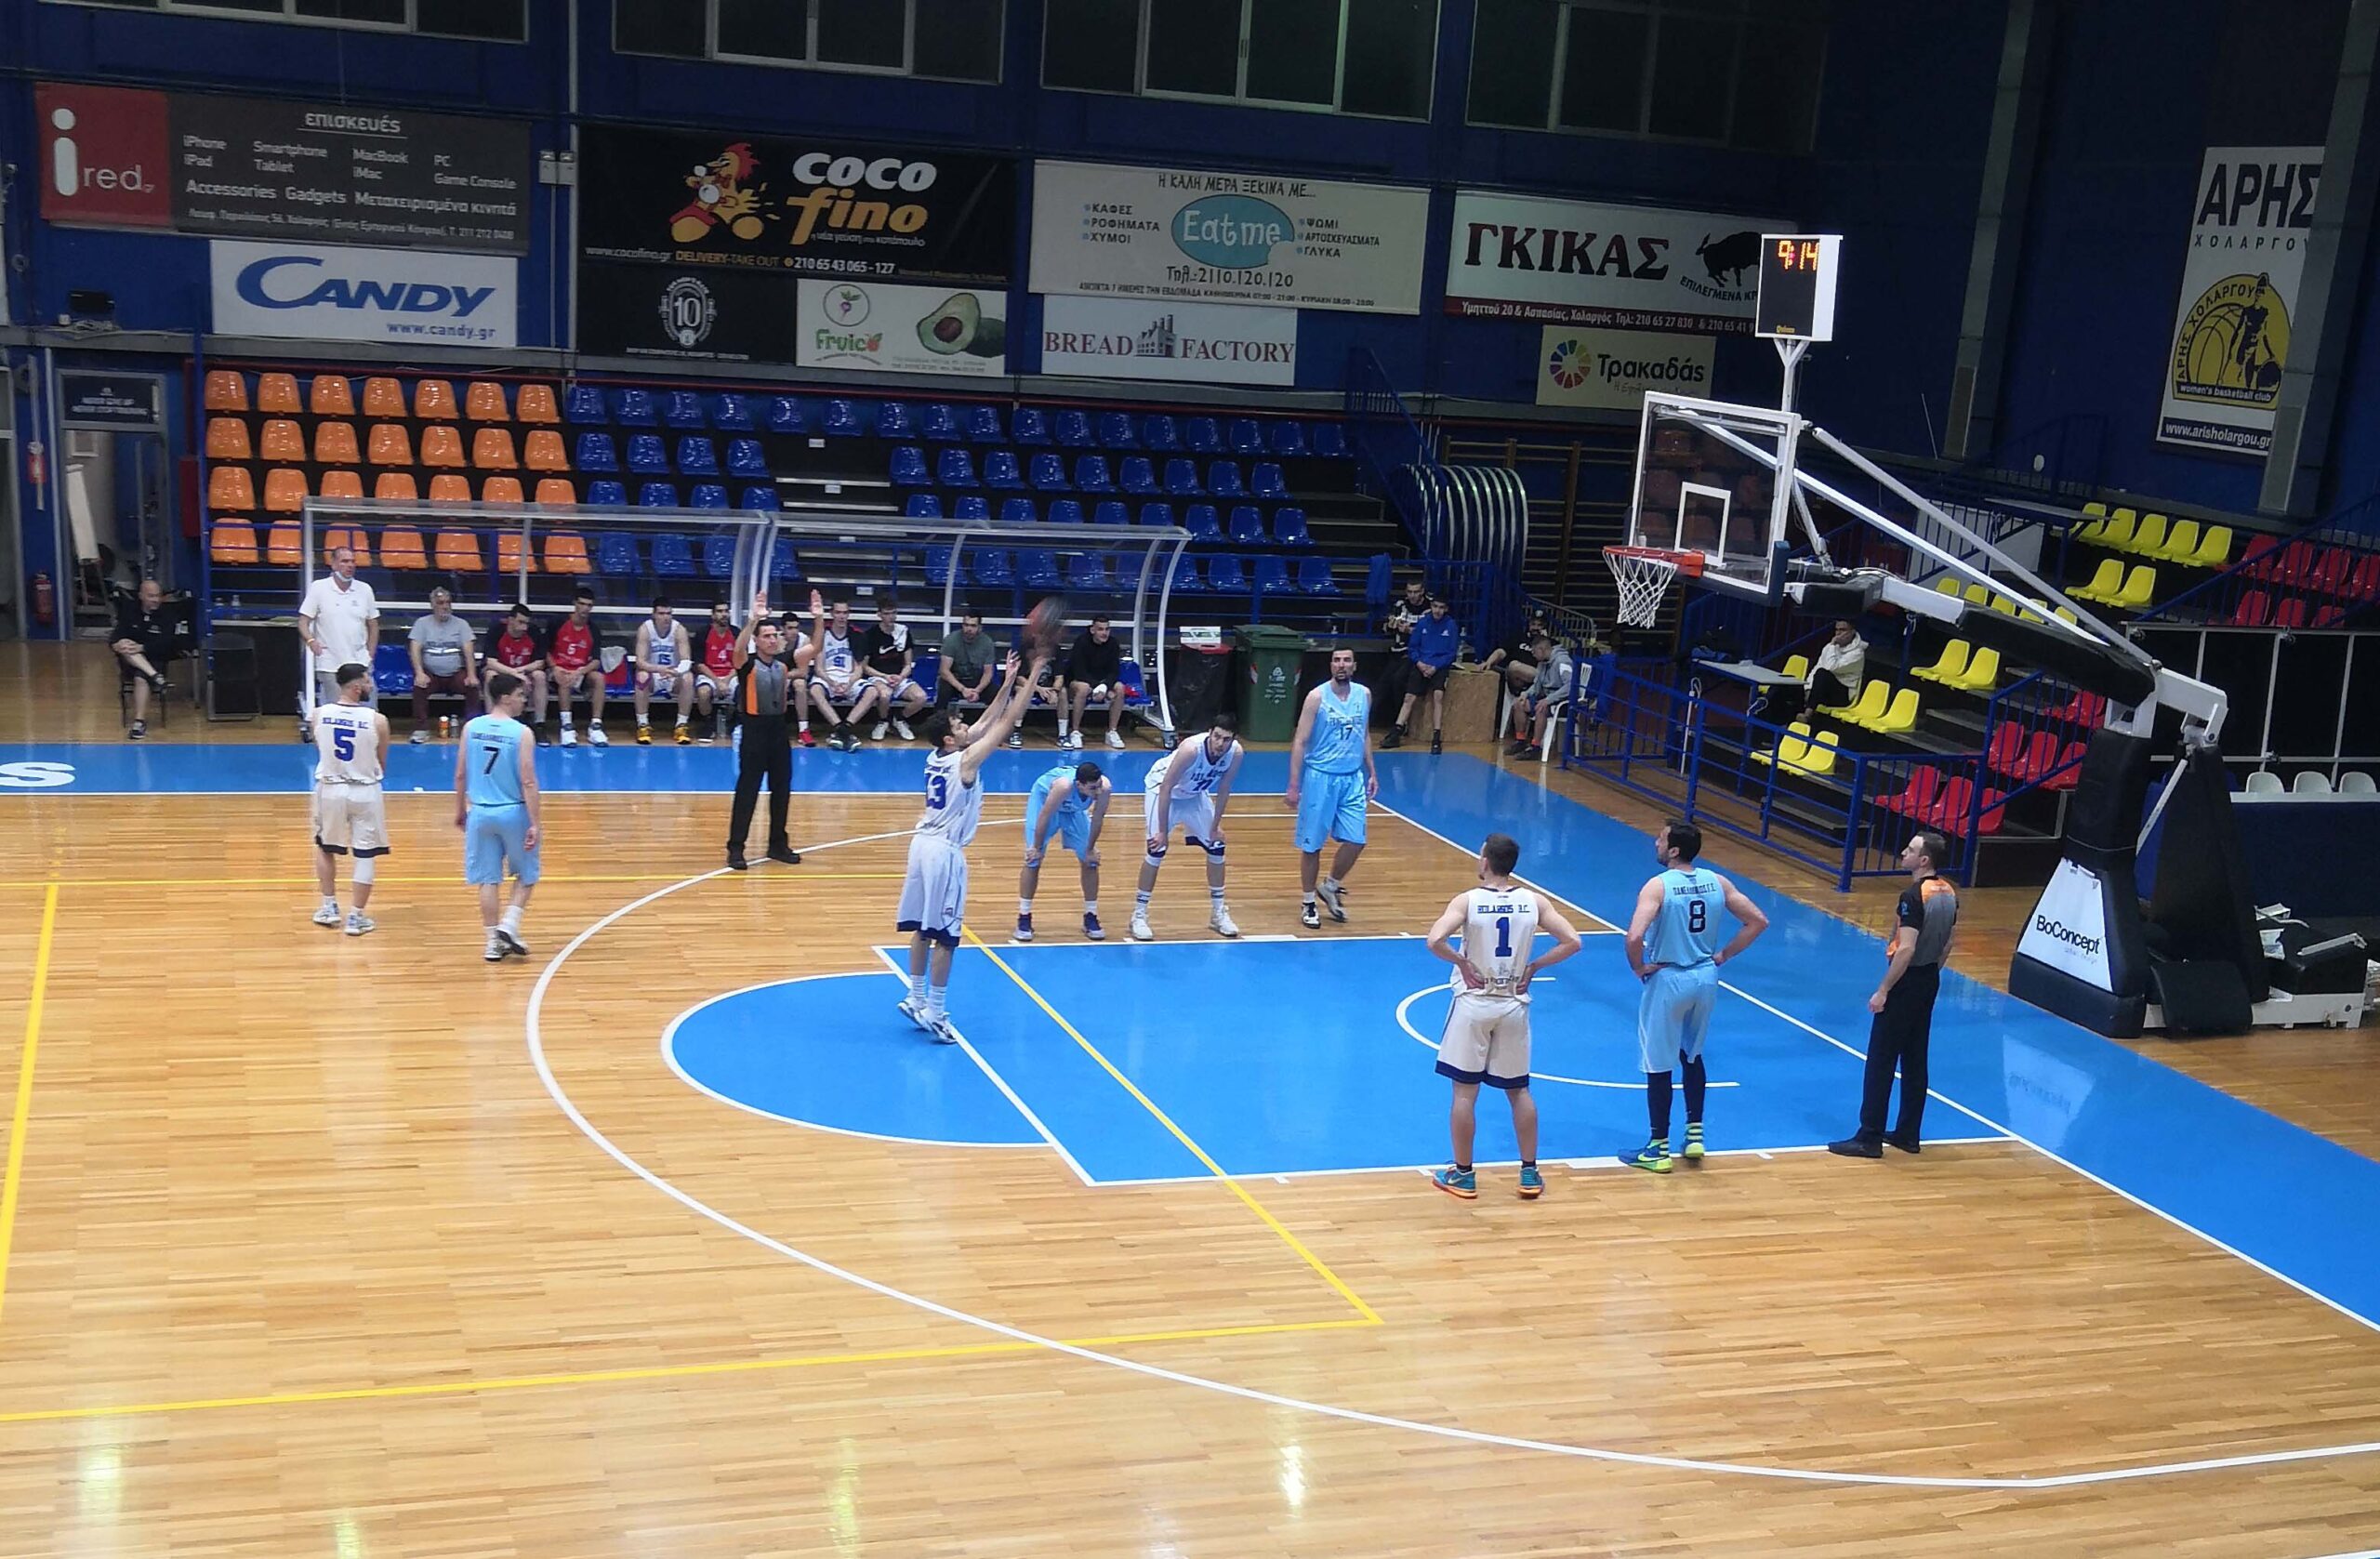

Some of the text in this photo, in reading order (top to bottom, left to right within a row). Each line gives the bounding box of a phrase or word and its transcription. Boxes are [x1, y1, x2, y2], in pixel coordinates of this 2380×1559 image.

[183, 135, 228, 151] iPhone
[253, 140, 327, 157] Smartphone
[183, 153, 214, 167] iPad
[253, 159, 296, 173] Tablet
[352, 148, 409, 164] MacBook
[433, 154, 452, 167] PC
[352, 166, 383, 179] iMac
[433, 173, 517, 190] Game Console
[186, 179, 277, 199] Accessories
[284, 186, 347, 205] Gadgets
[1158, 175, 1166, 189] Η
[1170, 175, 1201, 190] ΚΑΛΗ
[1205, 177, 1237, 192] ΜΕΡΑ
[1242, 179, 1284, 195] ΞΕΚΙΝΑ
[2196, 163, 2322, 229] ΑΡΗΣ
[786, 187, 929, 245] fino
[1091, 203, 1133, 215] ΚΑΦΕΣ
[1091, 218, 1160, 231] ΡΟΦΗΜΑΤΑ
[1183, 210, 1283, 247] Eat me
[1306, 218, 1339, 229] ΨΩΜΙ
[1090, 231, 1131, 244] ΧΥΜΟΙ
[2194, 234, 2307, 251] ΧΟΛΑΡΓΟ
[1303, 246, 1341, 258] ΓΛΥΚΑ
[1464, 221, 1670, 281] ΓΚΙΚΑΣ
[755, 256, 780, 267] OUT
[234, 256, 497, 318] CANDY
[1679, 275, 1742, 302] ΕΠΙΛΕΓΜΕΝΑ
[674, 296, 701, 326] 10
[1461, 300, 1501, 317] Υμηττού
[1501, 305, 1514, 316] 20
[1514, 306, 1522, 317] &
[1570, 309, 1612, 324] Χολαργός
[1634, 313, 1651, 325] 210
[1652, 315, 1663, 326] 65
[1664, 316, 1676, 327] 27
[1676, 317, 1693, 328] 830
[1707, 319, 1724, 330] 210
[1724, 320, 1735, 331] 65
[1736, 321, 1747, 332] 41
[386, 323, 497, 341] www.candy.gr
[2177, 284, 2255, 378] ΑΡΗΣ ΧΟΛΑΡΓΟΥ
[1044, 331, 1295, 363] BREAD FACTORY
[1596, 353, 1706, 383] Τρακαδάς
[2180, 384, 2271, 402] women's basketball club
[2165, 423, 2272, 448] www.arisholargou.gr
[333, 727, 356, 761] 5
[1340, 727, 1353, 741] 17
[483, 746, 500, 775] 7
[1687, 899, 1706, 933] 8
[1495, 917, 1513, 958] 1
[2036, 914, 2100, 955] BoConcept
